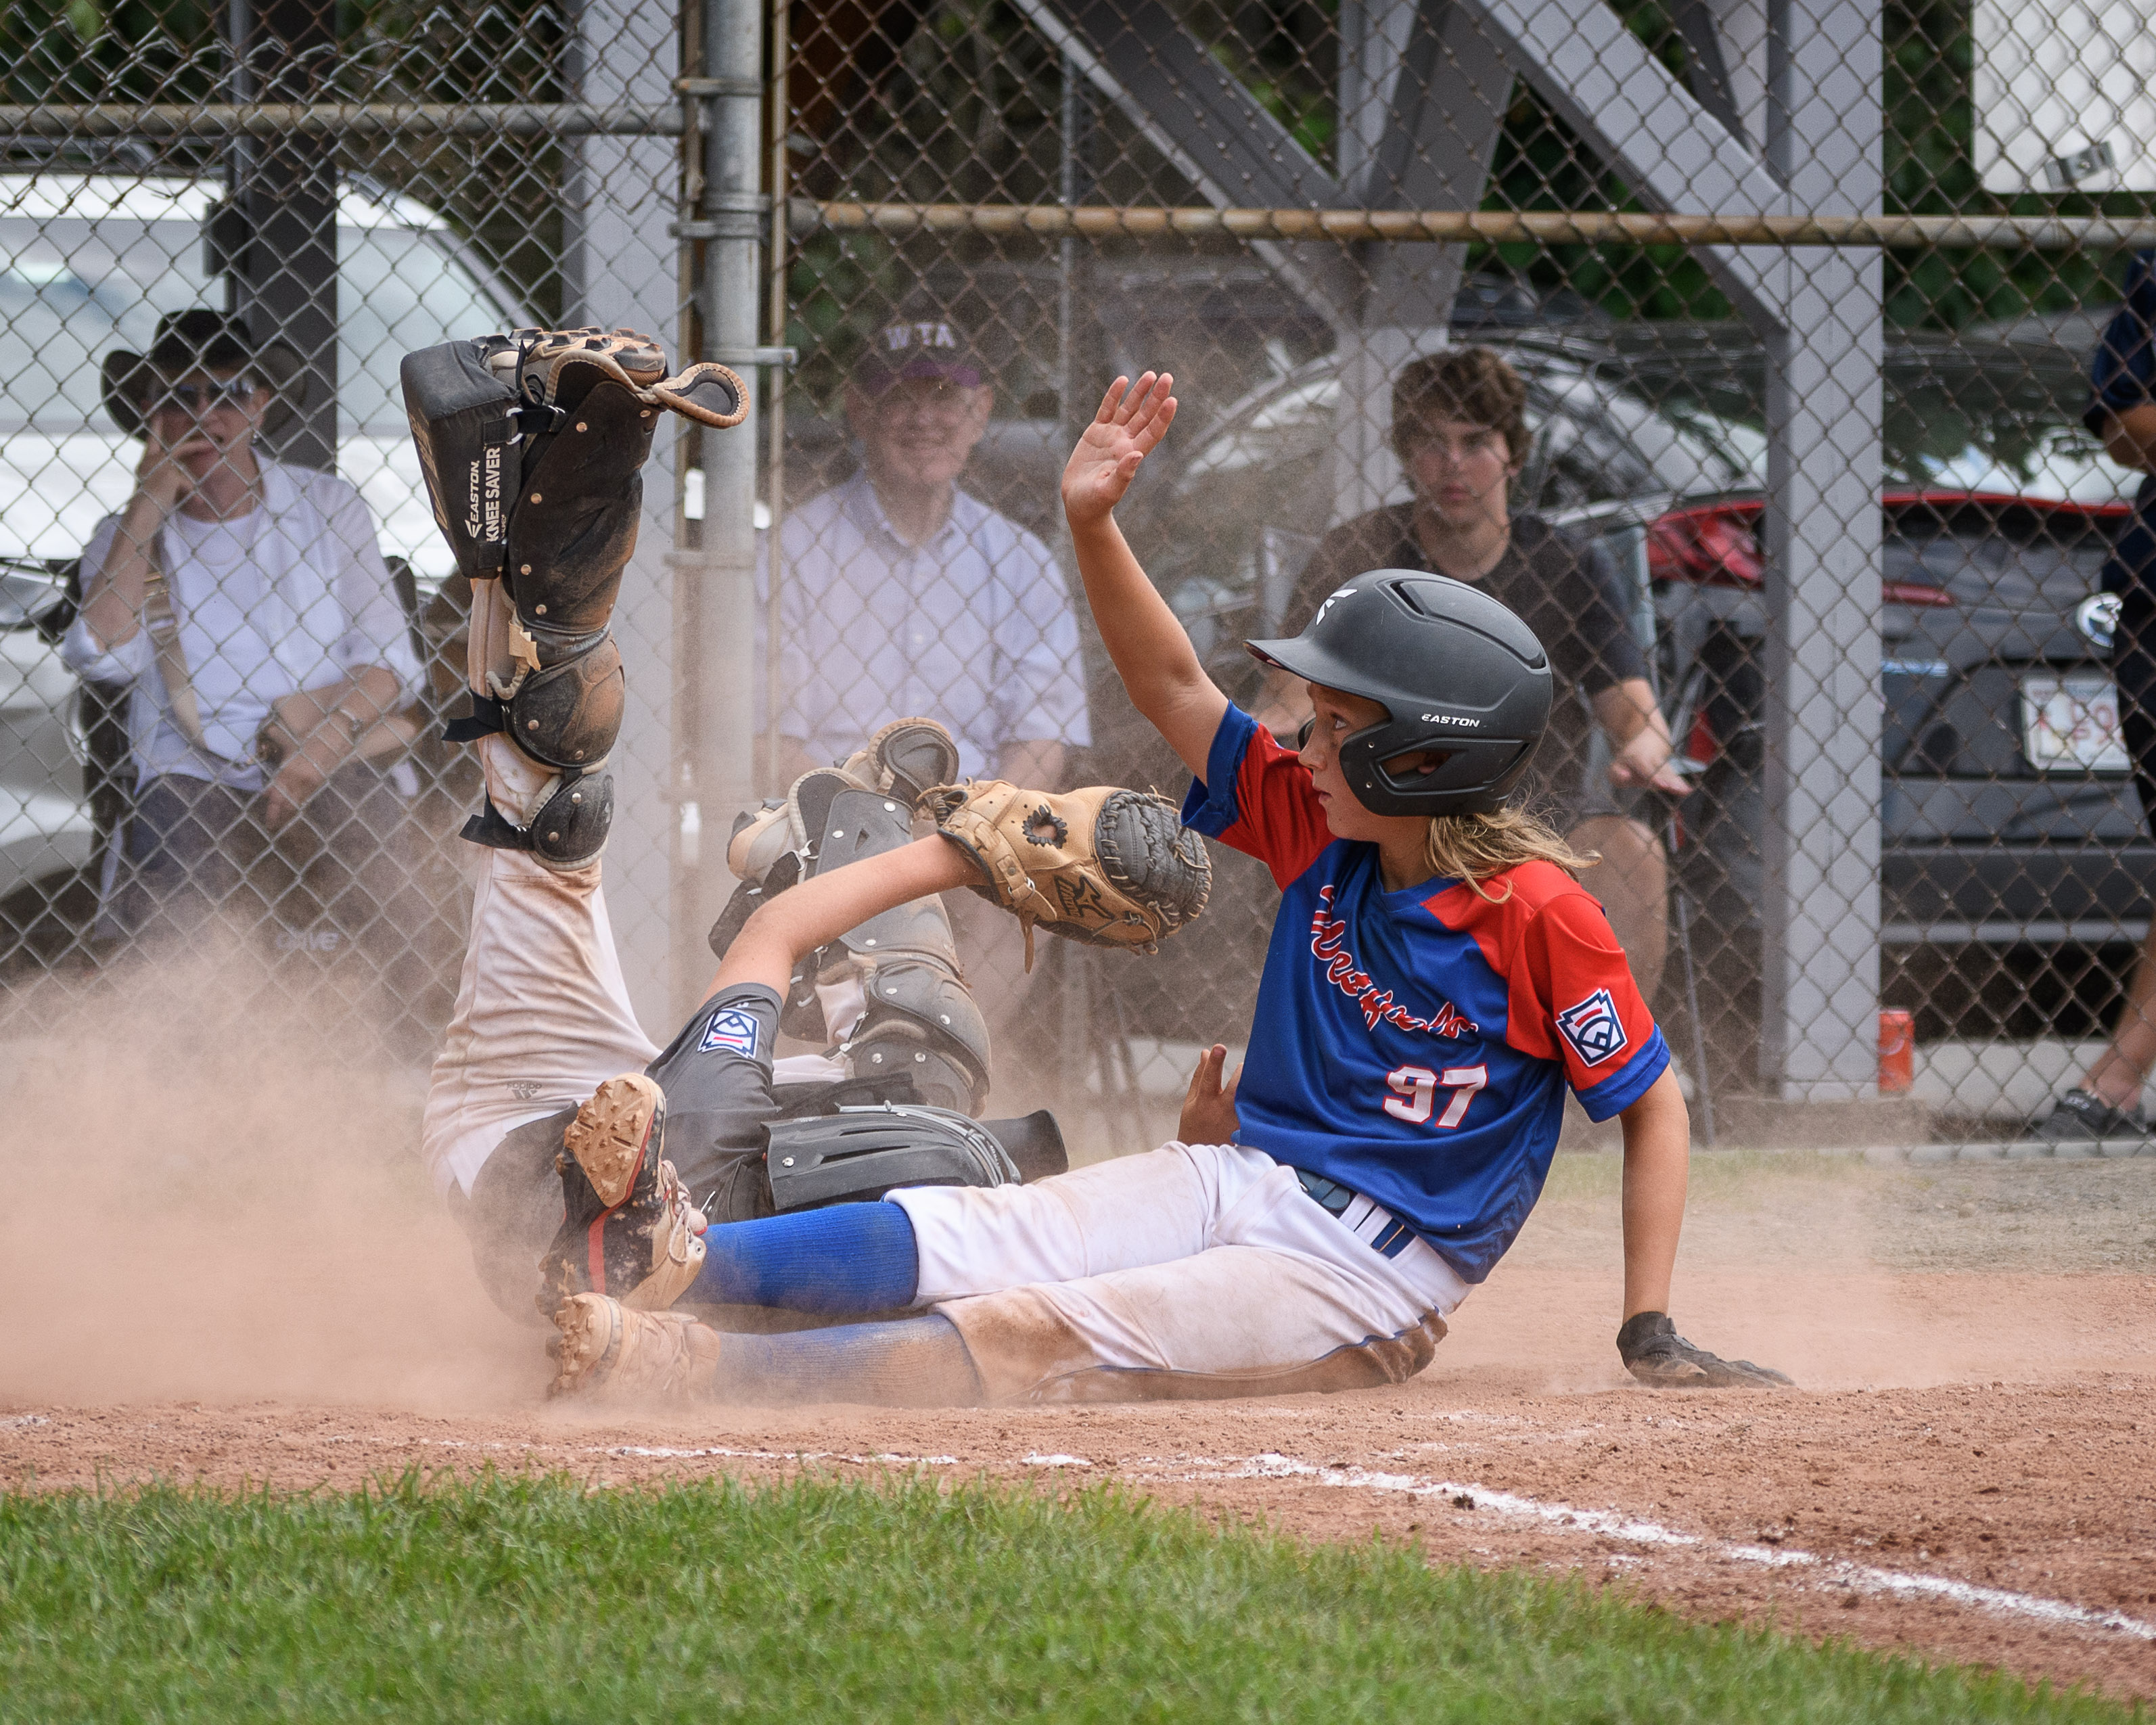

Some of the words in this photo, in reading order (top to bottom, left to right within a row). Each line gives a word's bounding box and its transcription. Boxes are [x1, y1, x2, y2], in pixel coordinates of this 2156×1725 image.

[886, 322, 956, 350] WTA
[469, 461, 480, 523] EASTON
[485, 446, 501, 499] SAVER
[485, 500, 500, 542] KNEE
[1421, 713, 1480, 728] EASTON
[506, 1082, 543, 1090] adidas
[1382, 1063, 1489, 1130] 97
